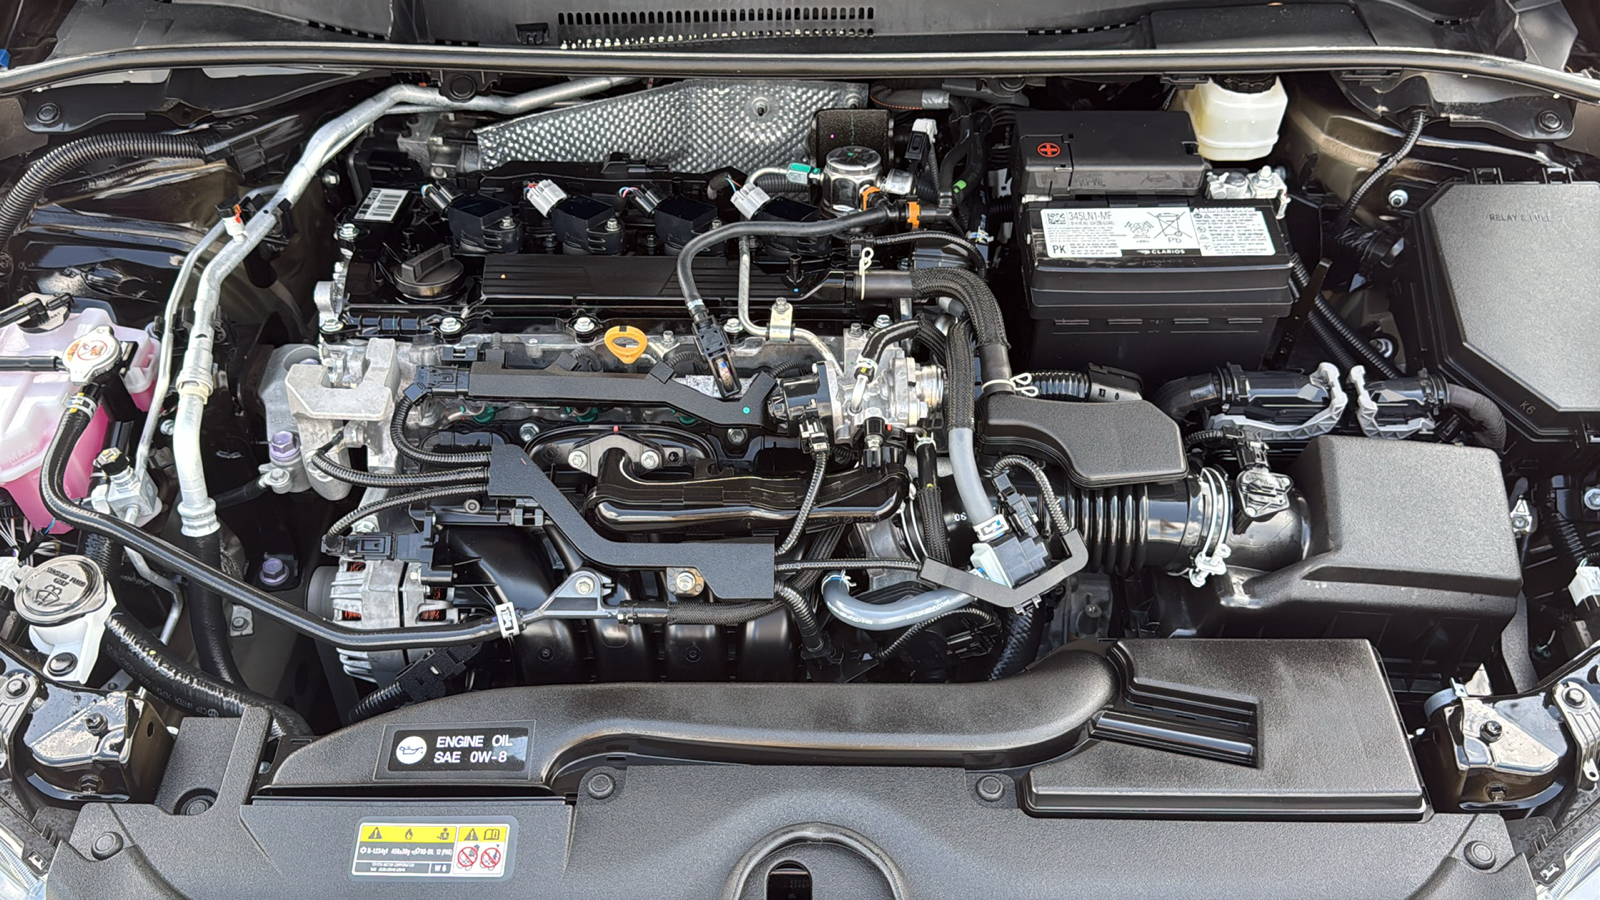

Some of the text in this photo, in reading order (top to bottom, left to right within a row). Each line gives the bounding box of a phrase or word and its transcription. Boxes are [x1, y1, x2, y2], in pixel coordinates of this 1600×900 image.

[1068, 211, 1112, 221] 345LN1-MF
[1052, 245, 1067, 254] PK
[1519, 400, 1537, 415] K6
[436, 734, 513, 748] ENGINE OIL
[433, 751, 508, 763] SAE 0W-8
[435, 864, 441, 872] W
